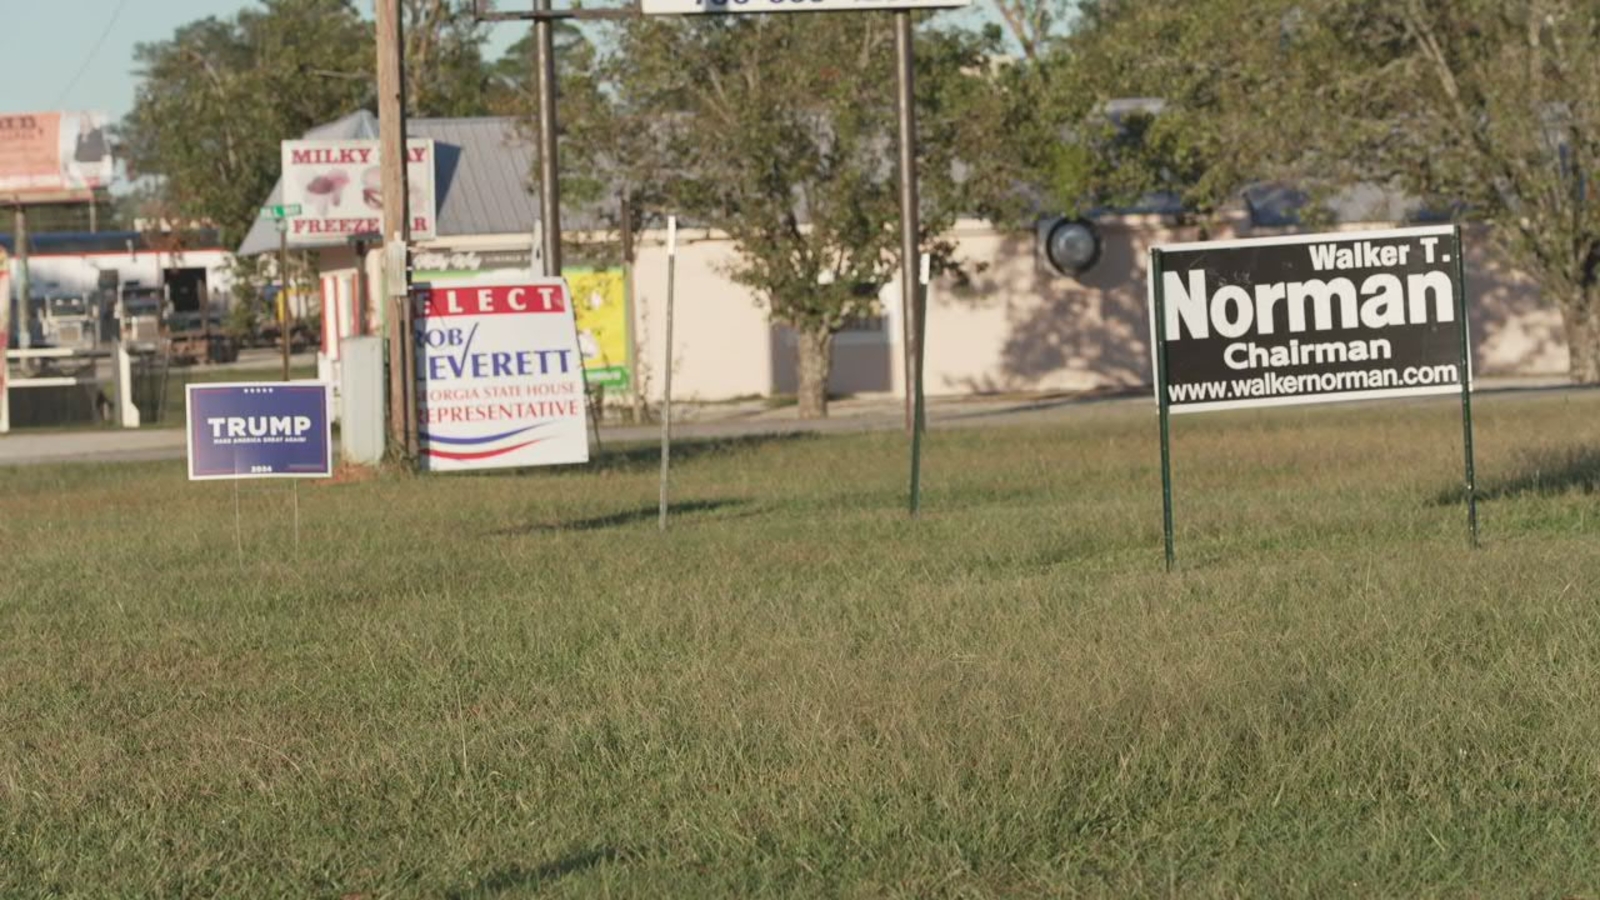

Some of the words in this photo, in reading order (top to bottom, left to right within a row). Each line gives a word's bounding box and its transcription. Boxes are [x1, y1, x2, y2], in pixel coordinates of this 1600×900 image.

[292, 149, 371, 164] MILKY
[294, 218, 380, 234] FREEZE
[1309, 241, 1410, 271] Walker
[1420, 236, 1451, 264] T.
[1163, 269, 1454, 341] Norman
[1223, 338, 1392, 370] Chairman
[483, 384, 522, 398] STATE
[526, 381, 577, 397] HOUSE
[1167, 364, 1458, 402] www.walkernorman.com
[207, 416, 311, 437] TRUMP
